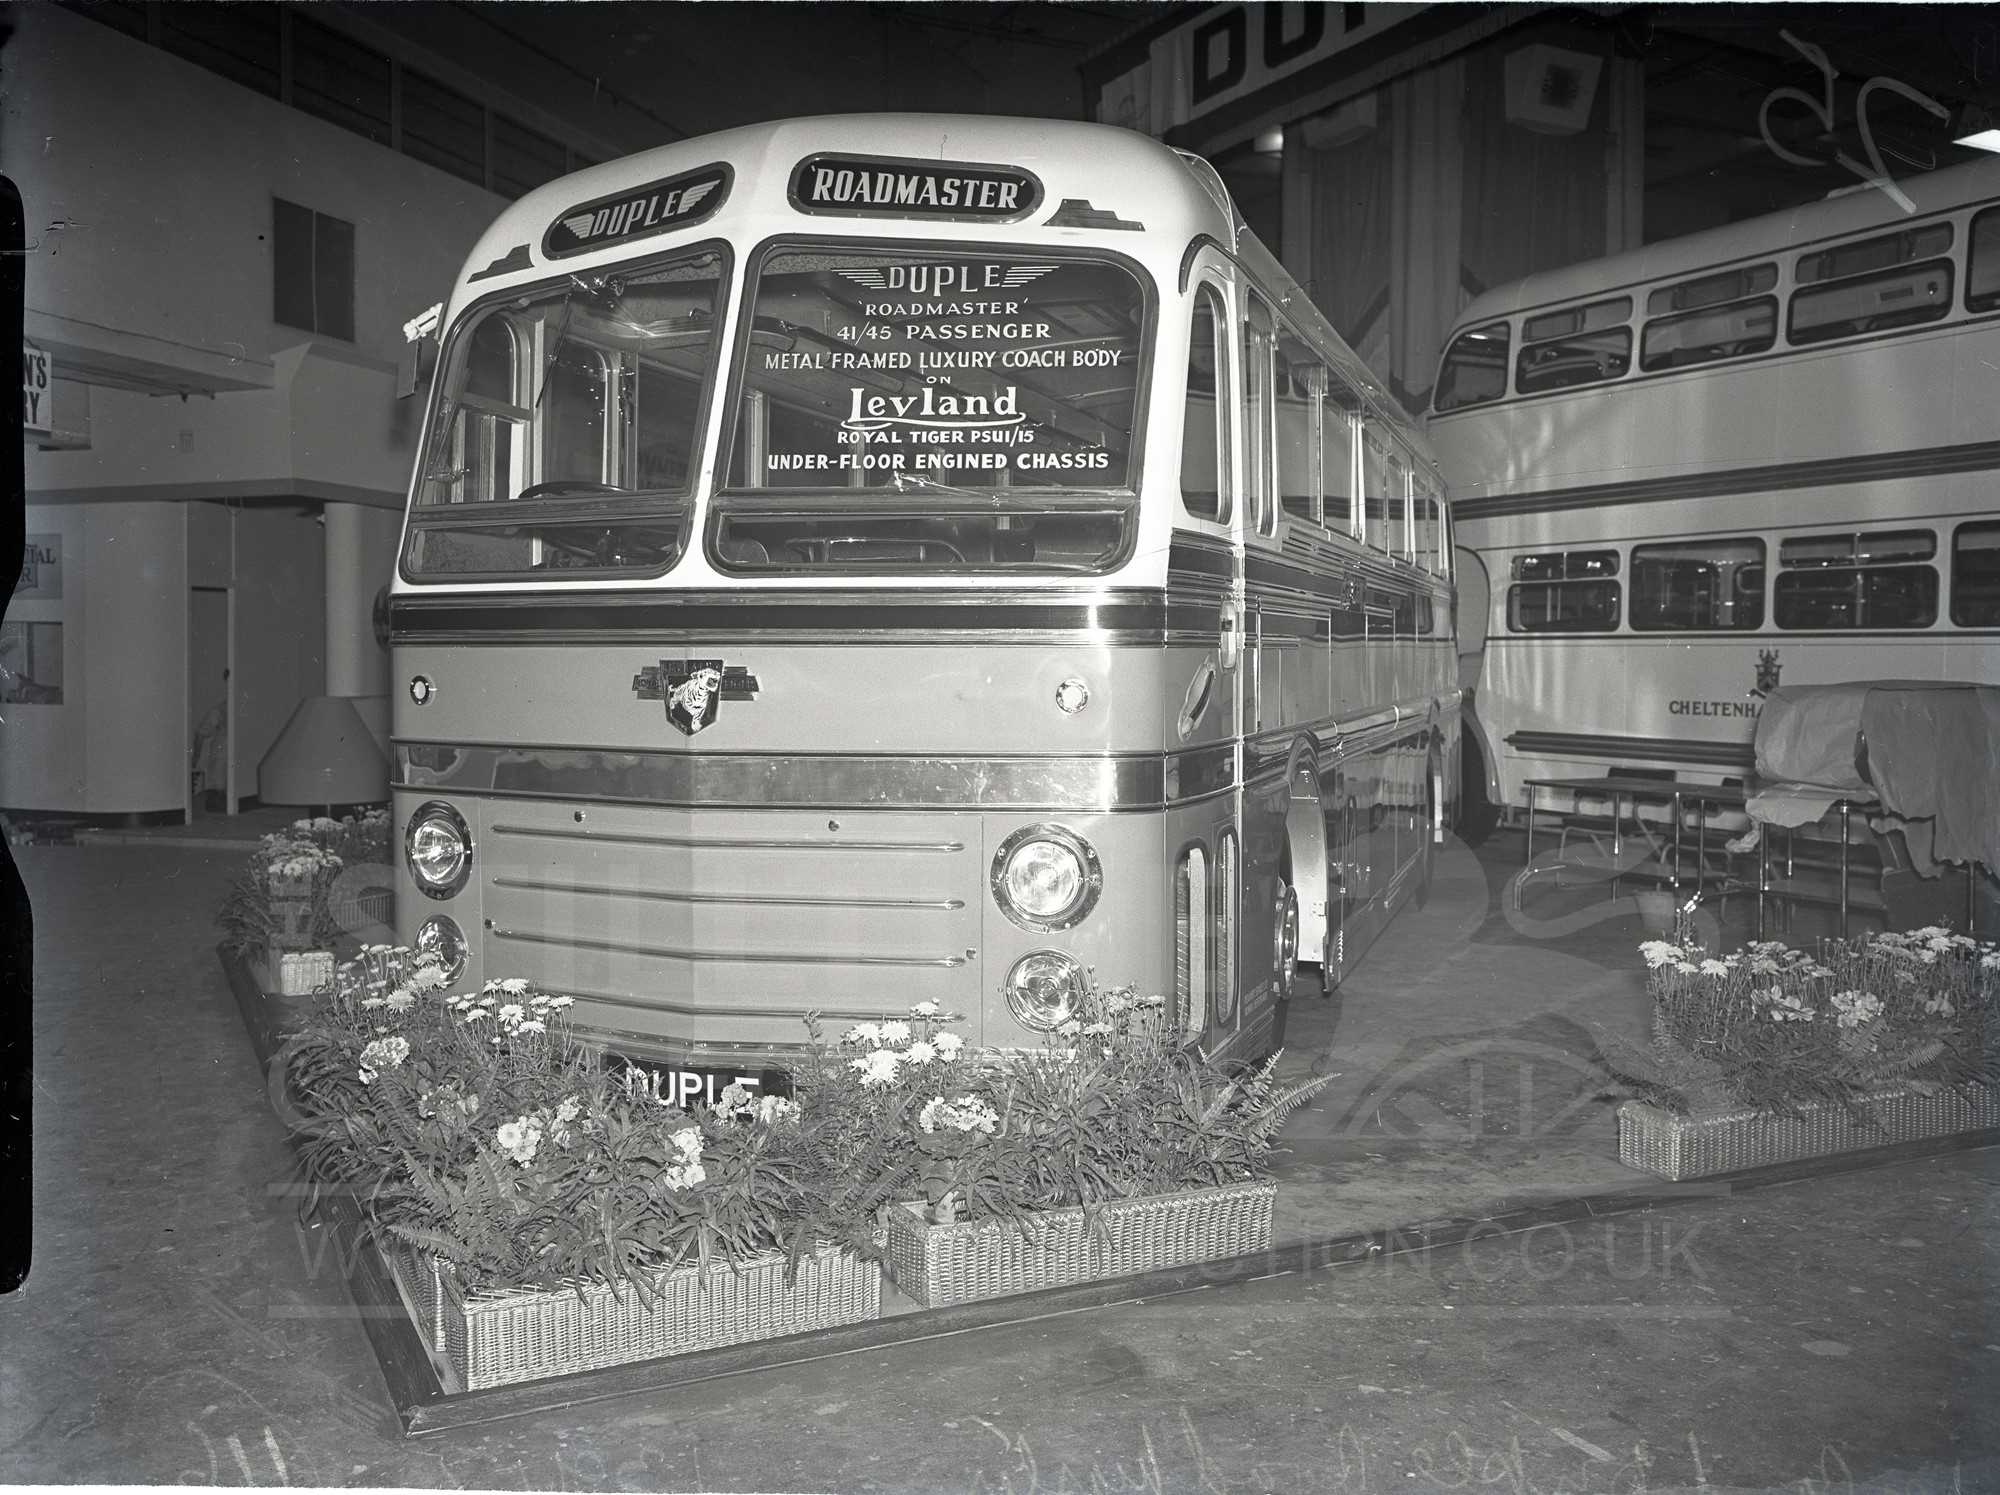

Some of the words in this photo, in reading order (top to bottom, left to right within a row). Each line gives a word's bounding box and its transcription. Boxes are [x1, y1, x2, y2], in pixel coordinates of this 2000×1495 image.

[1193, 2, 1366, 107] DU
[591, 192, 681, 237] DUPLE
[887, 266, 1001, 296] DUPLE
[837, 320, 892, 345] 41/45
[906, 323, 1052, 340] PASSENGER
[765, 353, 824, 370] METAL
[831, 352, 912, 369] FRAMED
[919, 351, 994, 369] LUXURY
[1002, 349, 1065, 368] COACH
[1072, 349, 1121, 367] BODY
[926, 375, 951, 386] ON
[845, 387, 1023, 427] Leyland
[837, 431, 902, 445] ROYAL
[909, 430, 965, 445] TIGER
[768, 453, 905, 471] UNDER-FLOOR
[915, 453, 1007, 471] ENGINED
[1016, 452, 1109, 470] CHASSIS
